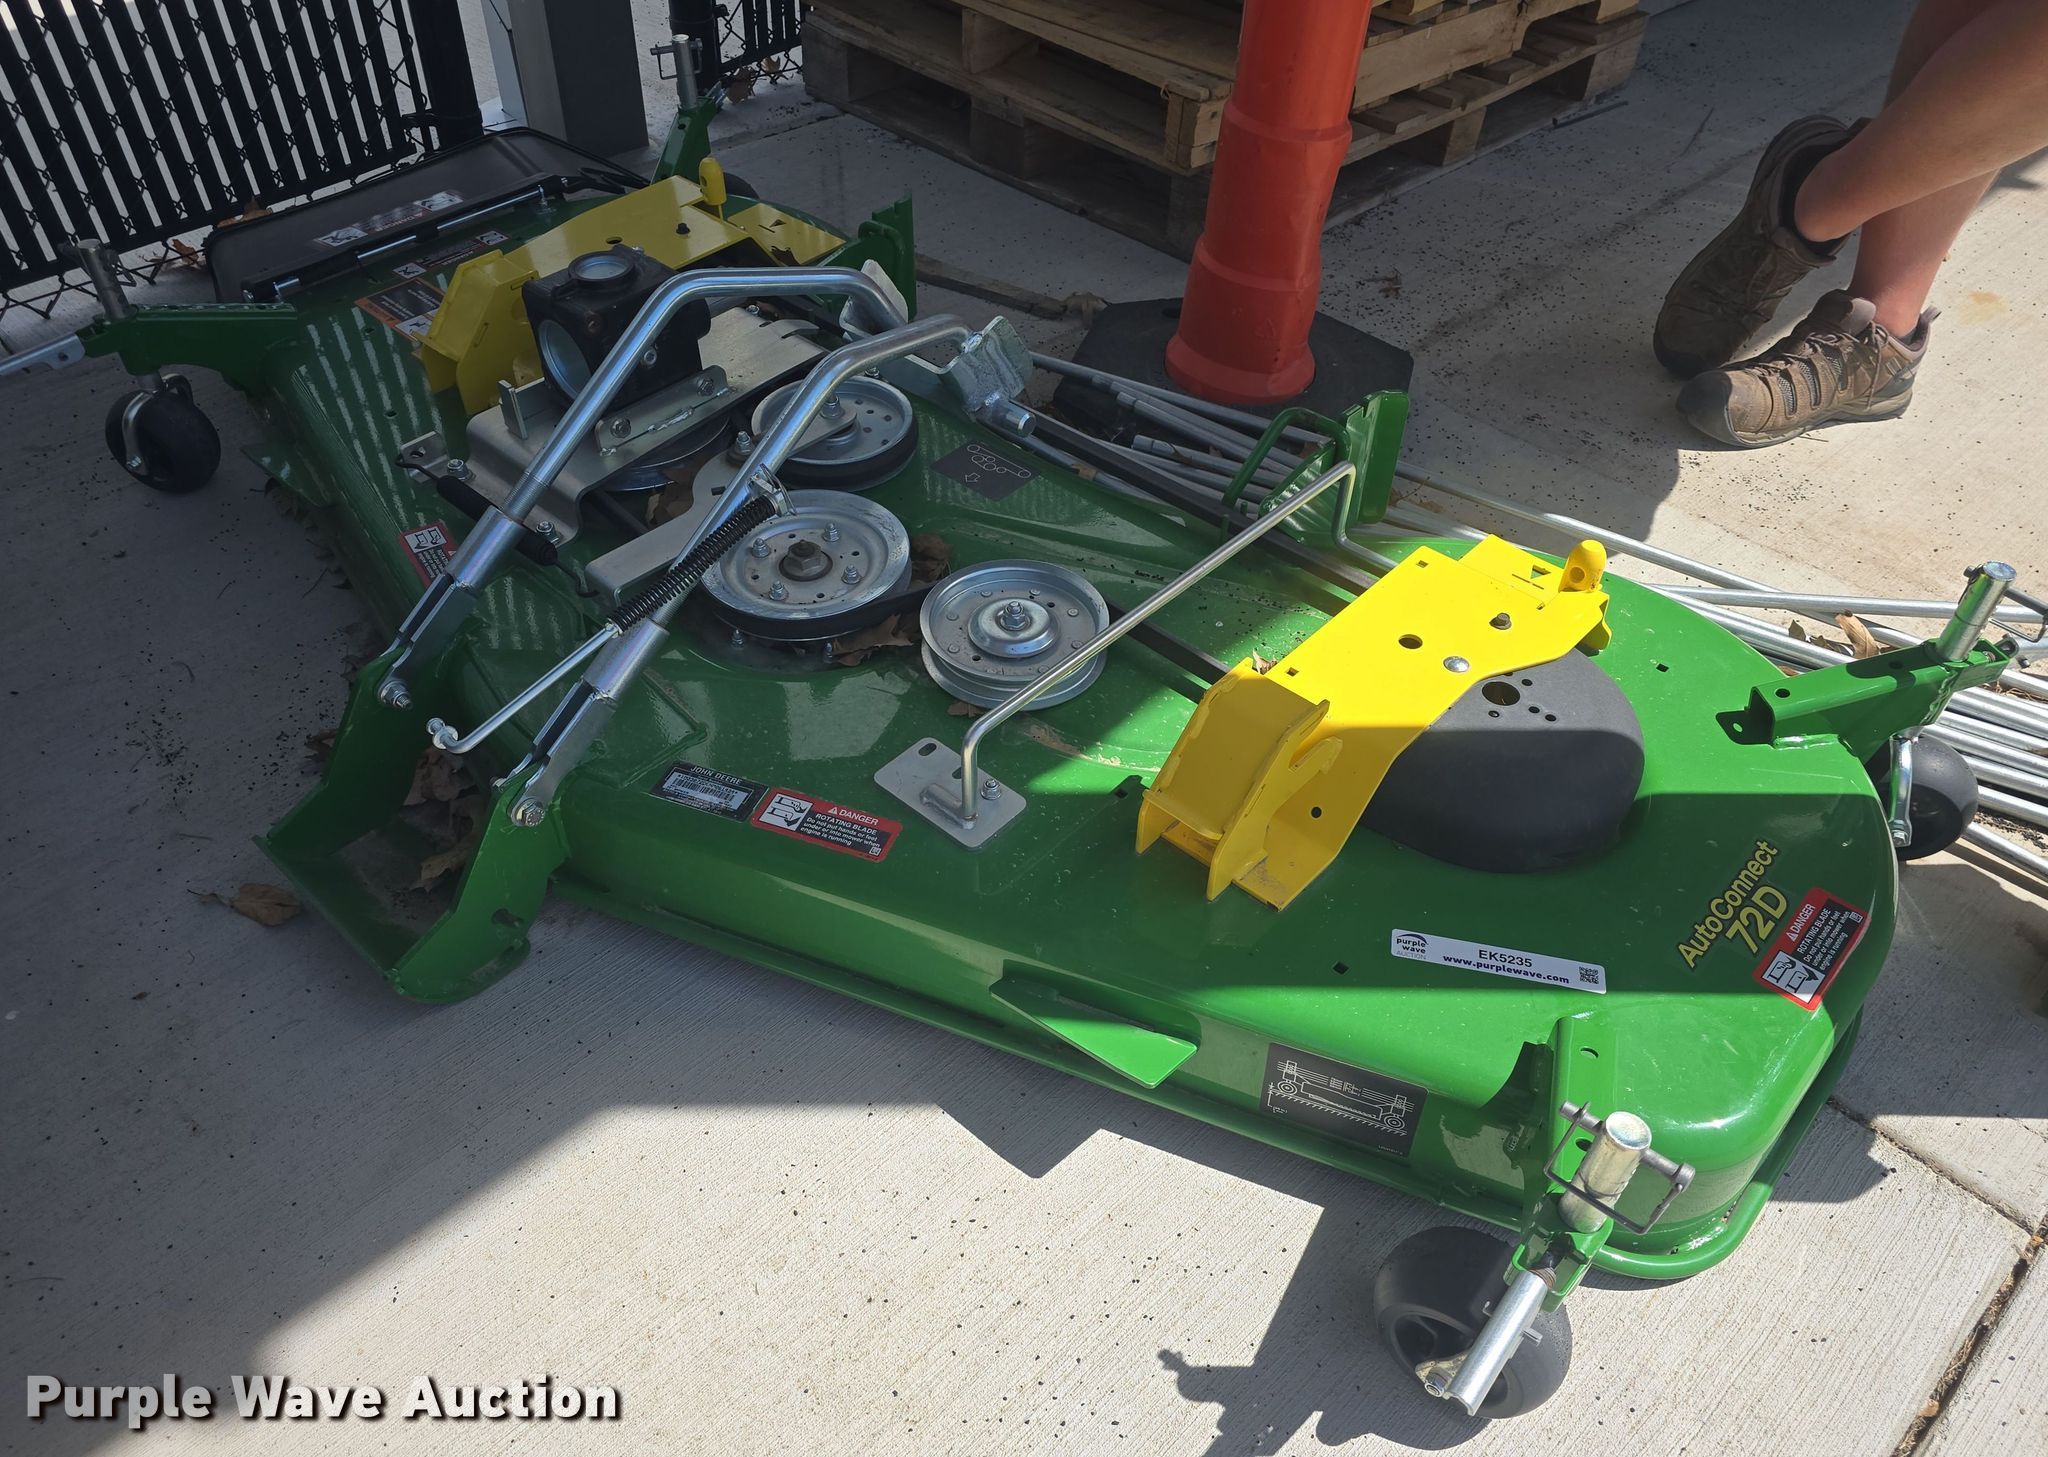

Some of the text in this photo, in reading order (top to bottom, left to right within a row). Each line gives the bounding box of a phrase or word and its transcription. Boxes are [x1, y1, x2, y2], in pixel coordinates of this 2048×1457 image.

[691, 766, 713, 776] JOHN
[715, 772, 741, 785] DEERE
[816, 813, 877, 835] ROTATING BLADE
[839, 809, 879, 825] DANGER
[801, 827, 821, 837] engine
[828, 834, 852, 846] running
[804, 822, 820, 831] under
[830, 827, 841, 836] into
[843, 833, 863, 843] mower
[864, 838, 880, 848] when
[817, 819, 826, 827] not
[827, 822, 837, 830] put
[838, 824, 856, 834] hands
[866, 833, 877, 841] feet
[1679, 841, 1778, 969] AutoConnect
[1725, 886, 1787, 954] 72D
[1791, 904, 1815, 933] DANGER
[1797, 908, 1830, 953] ROTATING BLADE
[1396, 936, 1426, 948] purple
[1803, 951, 1812, 962] Do
[1809, 944, 1817, 955] not
[1814, 935, 1823, 947] put
[1819, 924, 1831, 938] hands
[1831, 910, 1841, 920] feet
[1812, 952, 1823, 966] under
[1831, 922, 1843, 938] mower
[1396, 951, 1427, 960] AUCTION
[1402, 945, 1426, 954] wave
[1478, 949, 1533, 967] EK5235
[1820, 954, 1833, 970] engine
[1833, 932, 1848, 950] running
[1442, 955, 1570, 984] www.purplewave.com
